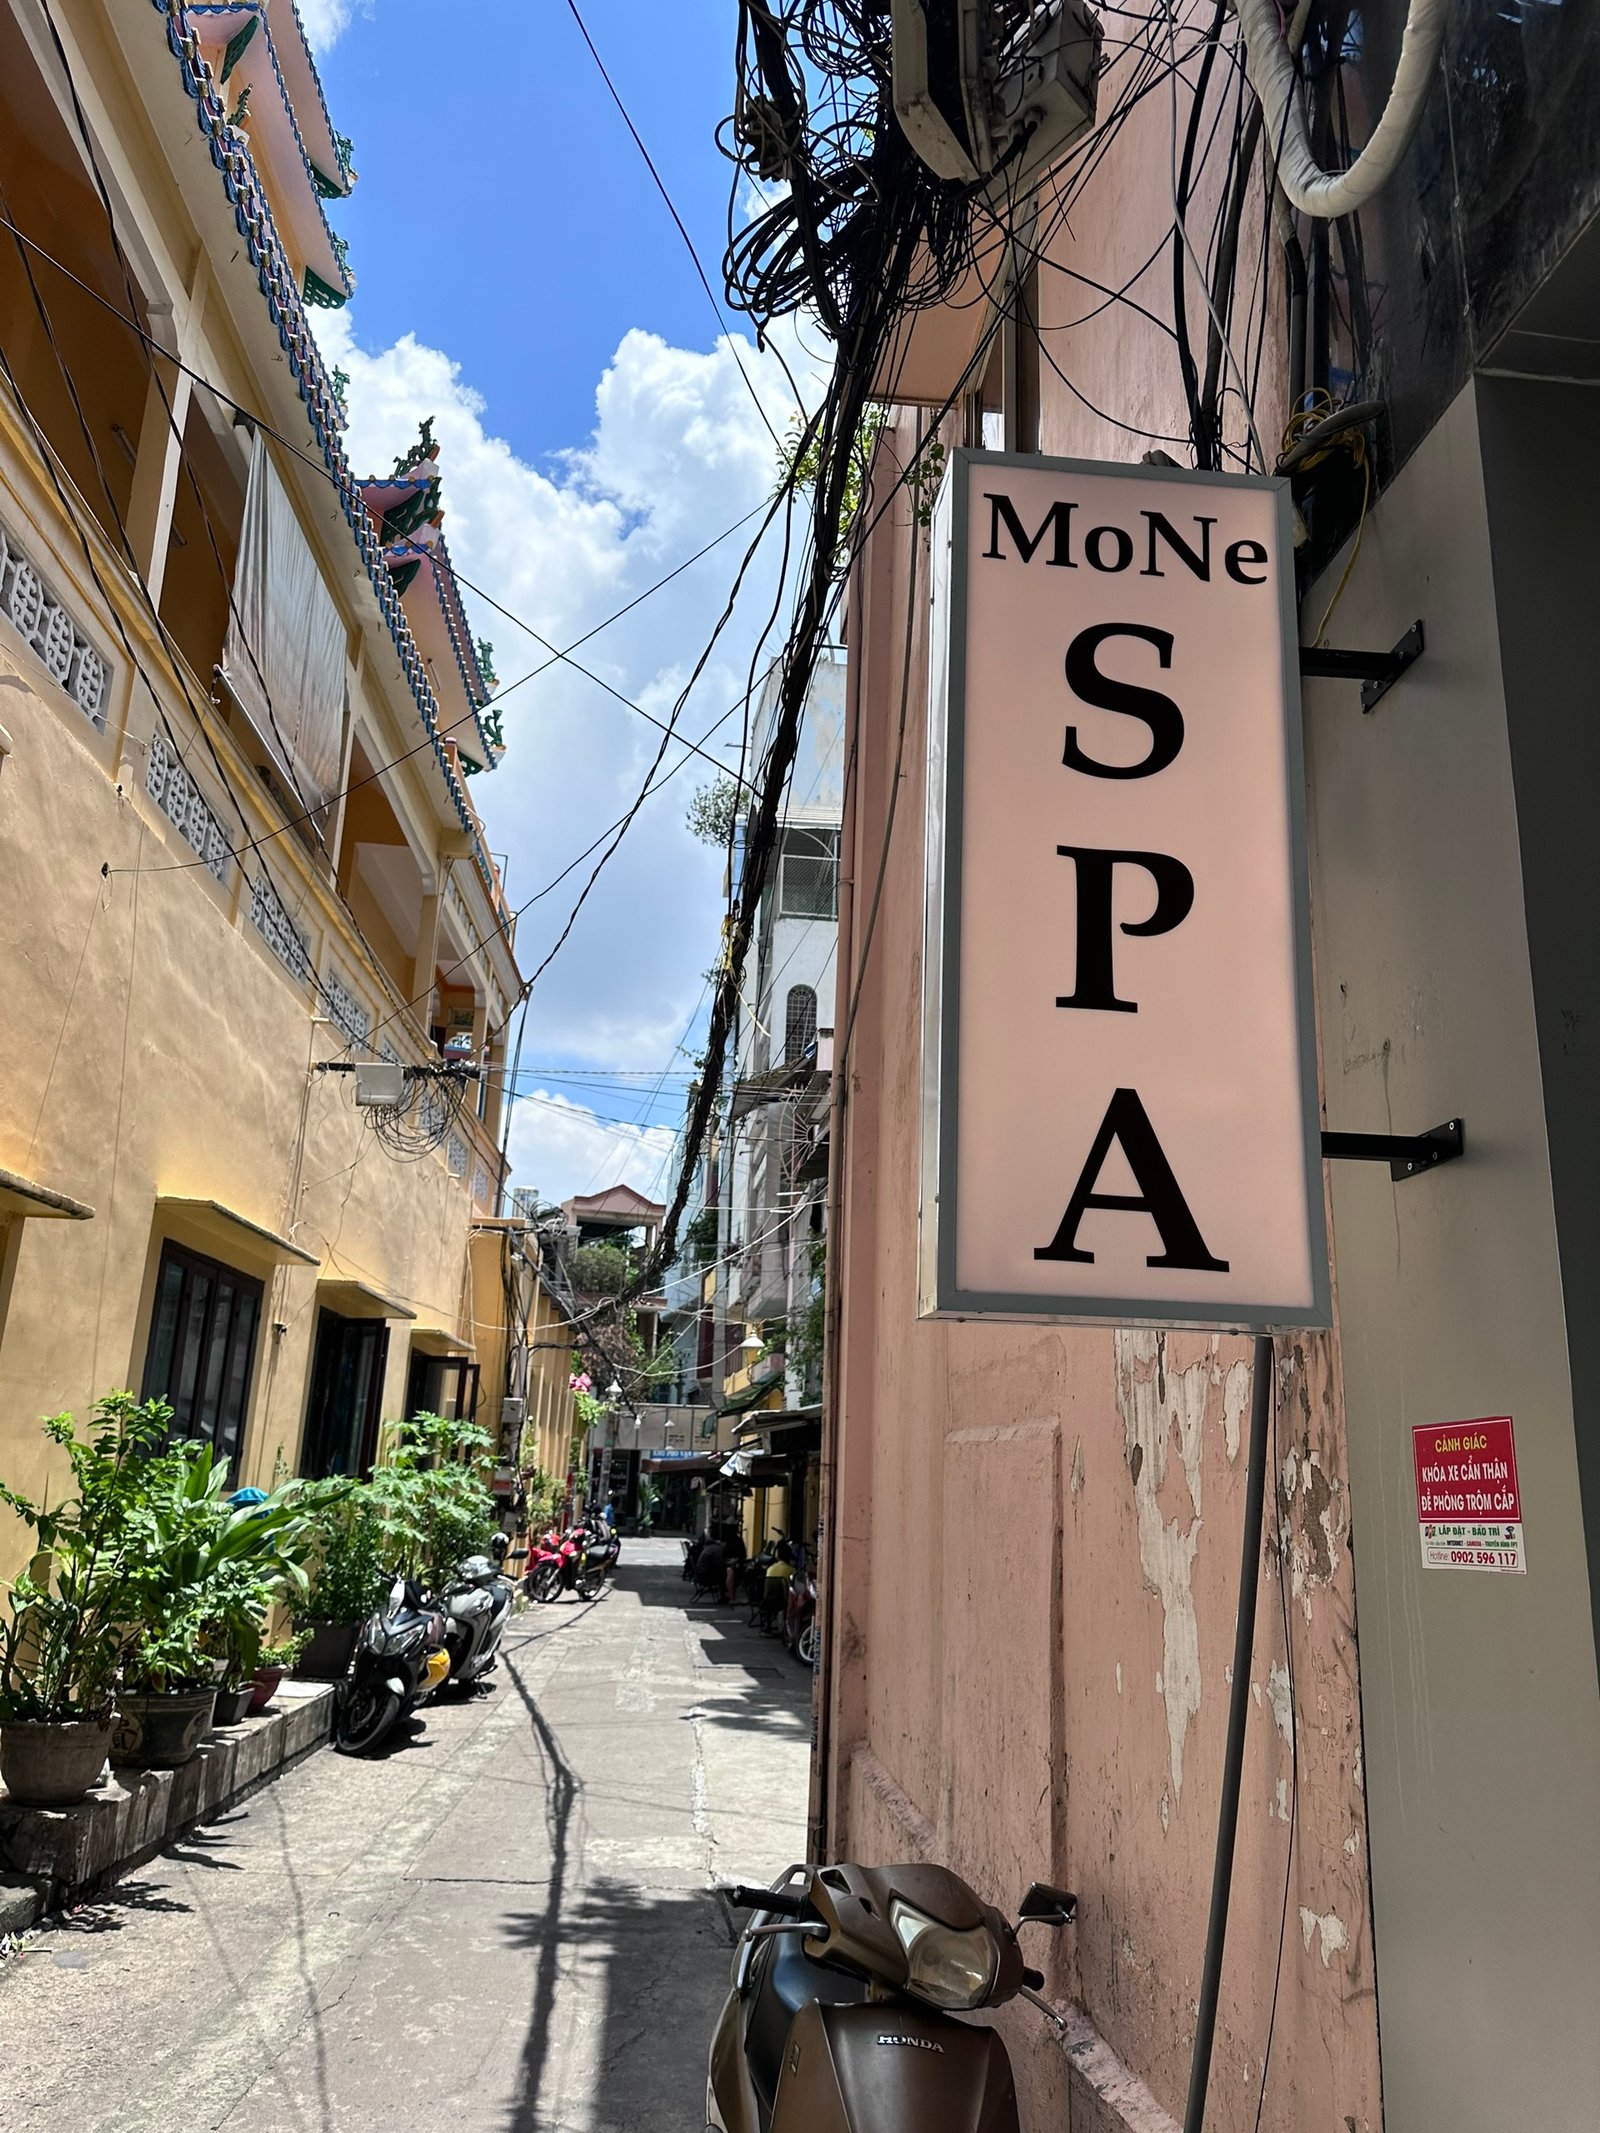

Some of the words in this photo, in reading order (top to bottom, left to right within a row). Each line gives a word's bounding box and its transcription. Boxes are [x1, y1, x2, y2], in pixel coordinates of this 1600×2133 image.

[982, 493, 1269, 584] MoNe
[1034, 622, 1231, 1273] SPA
[1435, 1434, 1461, 1453] CẢNH
[1463, 1432, 1488, 1450] GIÁC
[1422, 1461, 1446, 1482] KHÓA
[1448, 1465, 1459, 1481] XE
[1460, 1455, 1481, 1480] CẨN
[1482, 1458, 1508, 1483] THẬN
[1421, 1488, 1432, 1511] ĐỀ
[1433, 1491, 1464, 1512] PHÒNG
[1466, 1489, 1492, 1515] TRỘM
[1493, 1485, 1515, 1511] CẮP
[1450, 1551, 1474, 1563] 0902
[1477, 1551, 1495, 1565] 596
[1497, 1552, 1516, 1566] 117
[877, 2034, 945, 2054] HONDA
